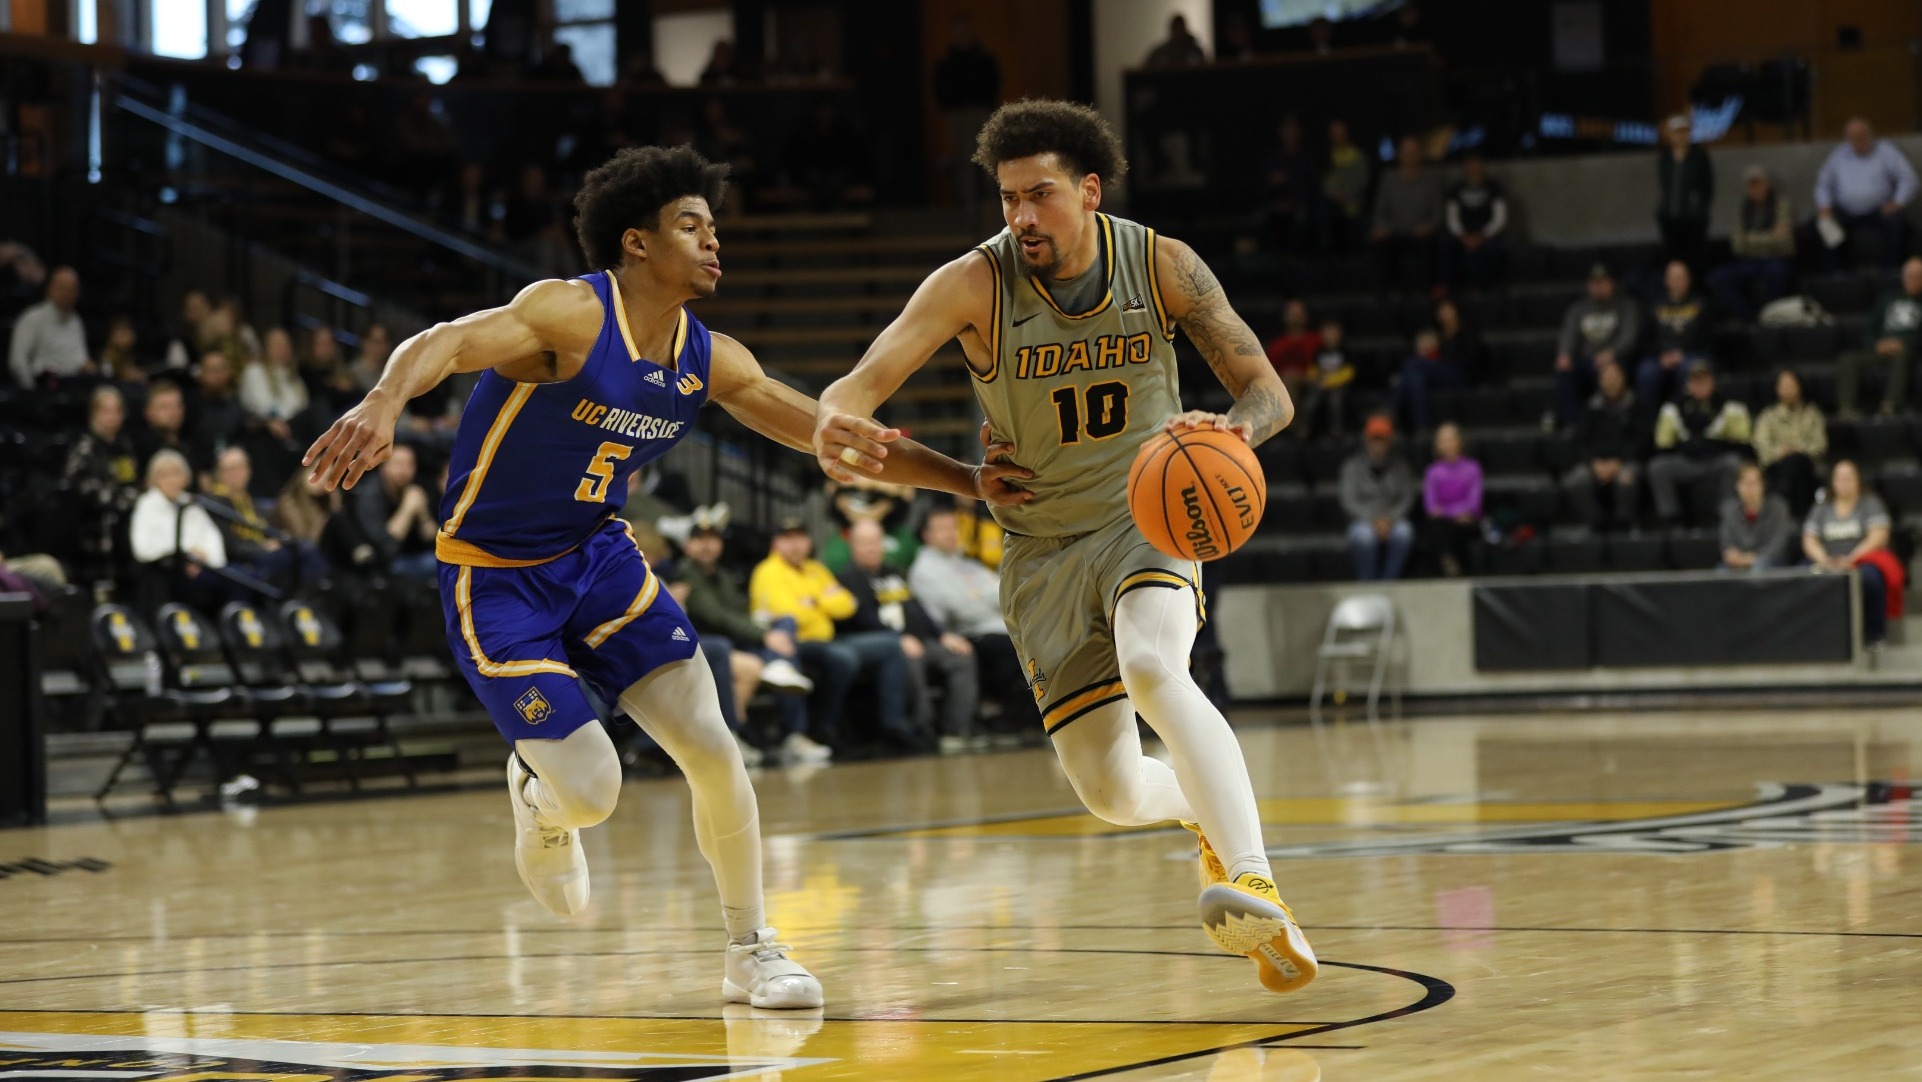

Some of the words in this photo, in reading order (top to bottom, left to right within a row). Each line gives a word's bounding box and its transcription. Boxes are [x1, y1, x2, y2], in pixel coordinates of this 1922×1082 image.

[644, 375, 666, 388] adidas
[1015, 331, 1152, 380] IDAHO
[571, 399, 607, 426] UC
[1050, 379, 1131, 447] 10
[574, 441, 634, 503] 5
[1181, 484, 1220, 560] Wilson
